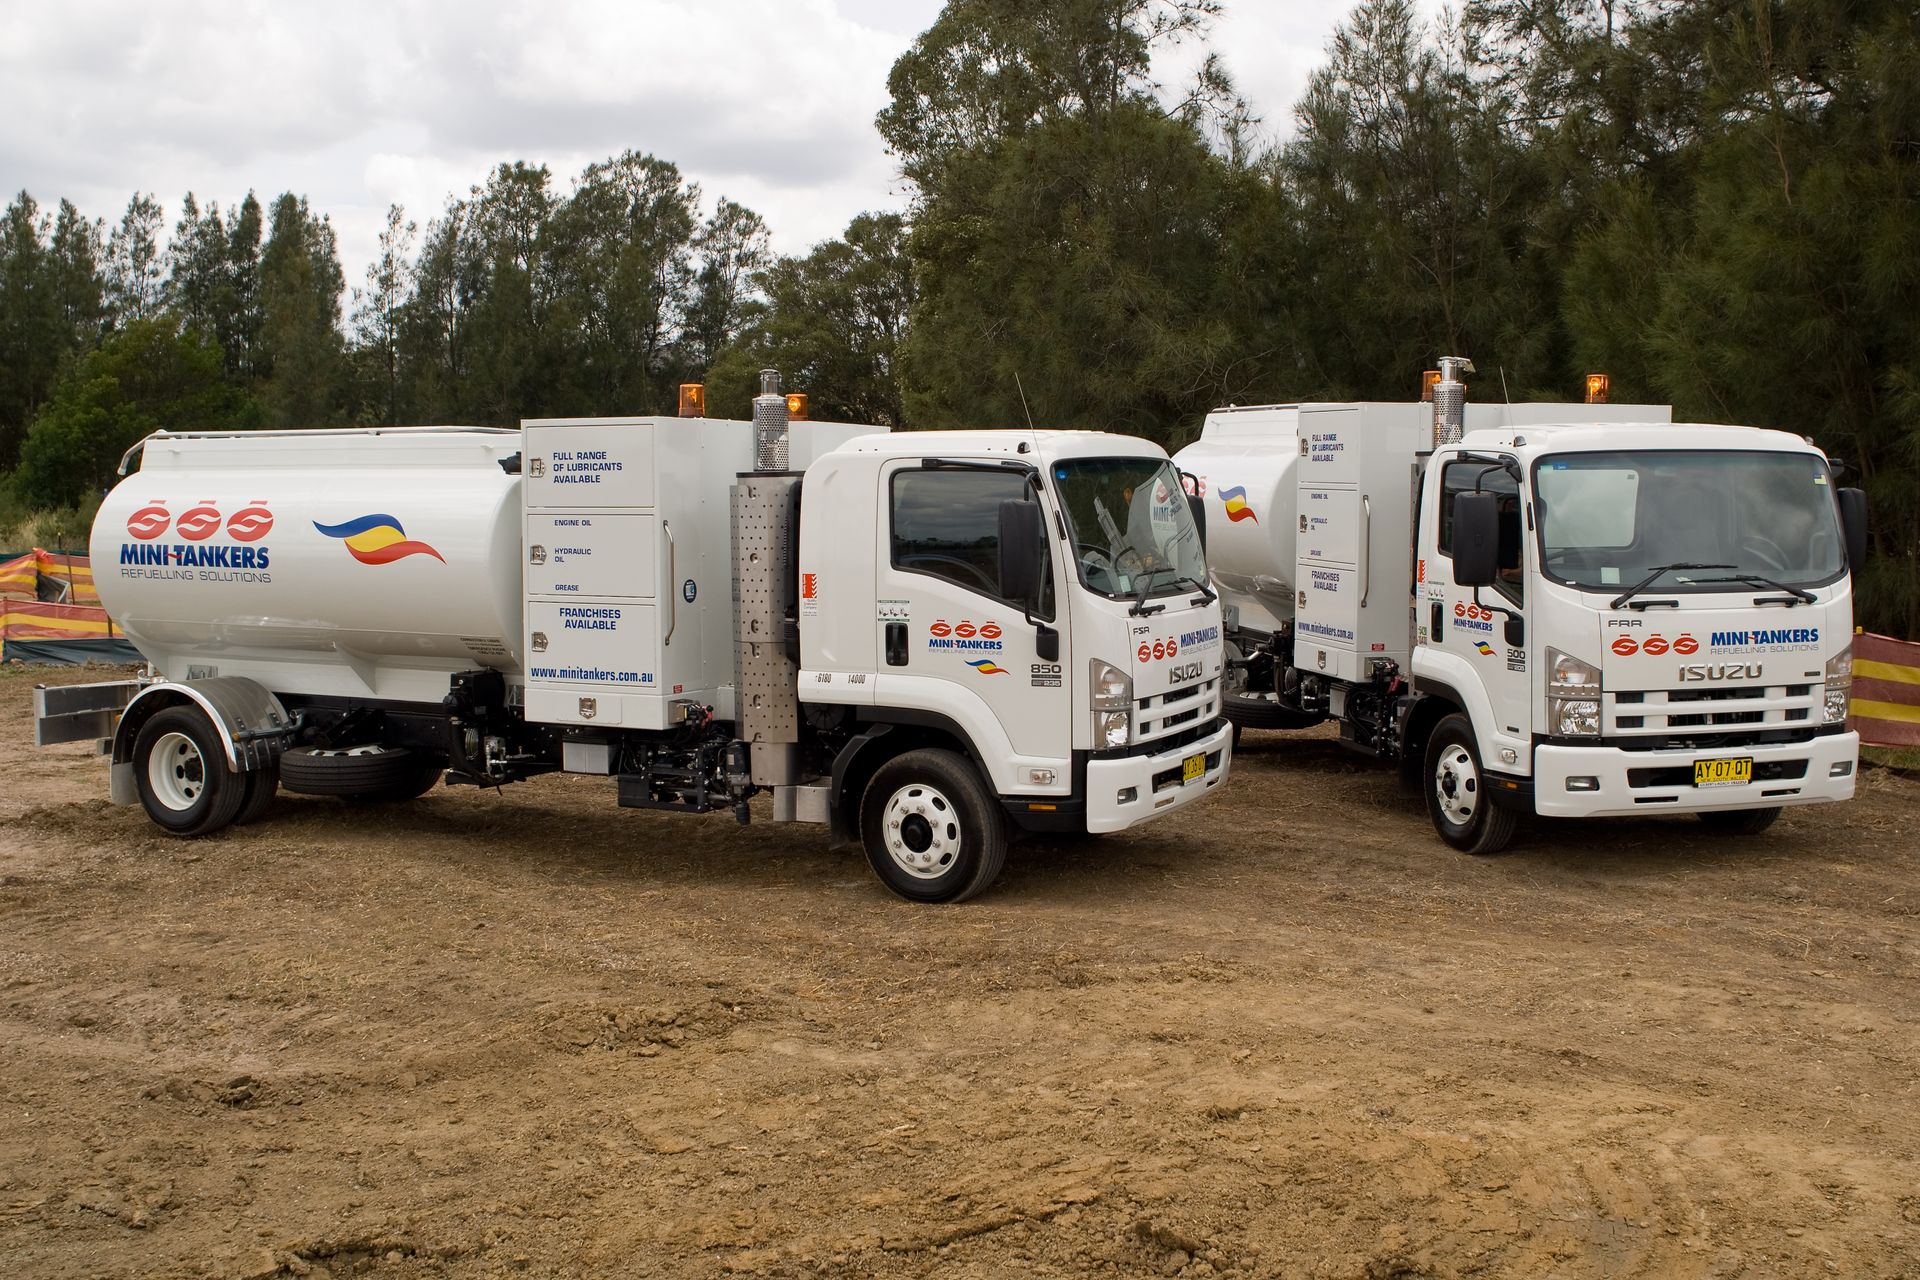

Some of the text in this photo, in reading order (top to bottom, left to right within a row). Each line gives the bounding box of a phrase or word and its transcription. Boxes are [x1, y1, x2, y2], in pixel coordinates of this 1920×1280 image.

[1318, 443, 1344, 451] LUBRICANTS
[553, 451, 607, 460] FULL RANGE
[553, 462, 622, 471] OF LUBRICANTS
[553, 475, 600, 483] AVAILABLE
[121, 568, 272, 583] REFUELLING SOLUTIONS
[1312, 570, 1340, 582] FRANCHISES
[1313, 581, 1337, 592] AVAILABLE
[559, 607, 621, 619] FRANCHISES
[564, 619, 616, 631] AVAILABLE
[1608, 619, 1642, 628] FRR
[1133, 626, 1150, 635] FSR
[1507, 648, 1525, 659] 500
[1711, 644, 1819, 655] REFUELLING SOLUTIONS
[1031, 664, 1061, 673] 850
[1169, 661, 1203, 685] ISUZU
[1679, 661, 1762, 682] ISUZU
[531, 666, 653, 683] www.minitankers.com.au
[848, 674, 866, 684] 14000
